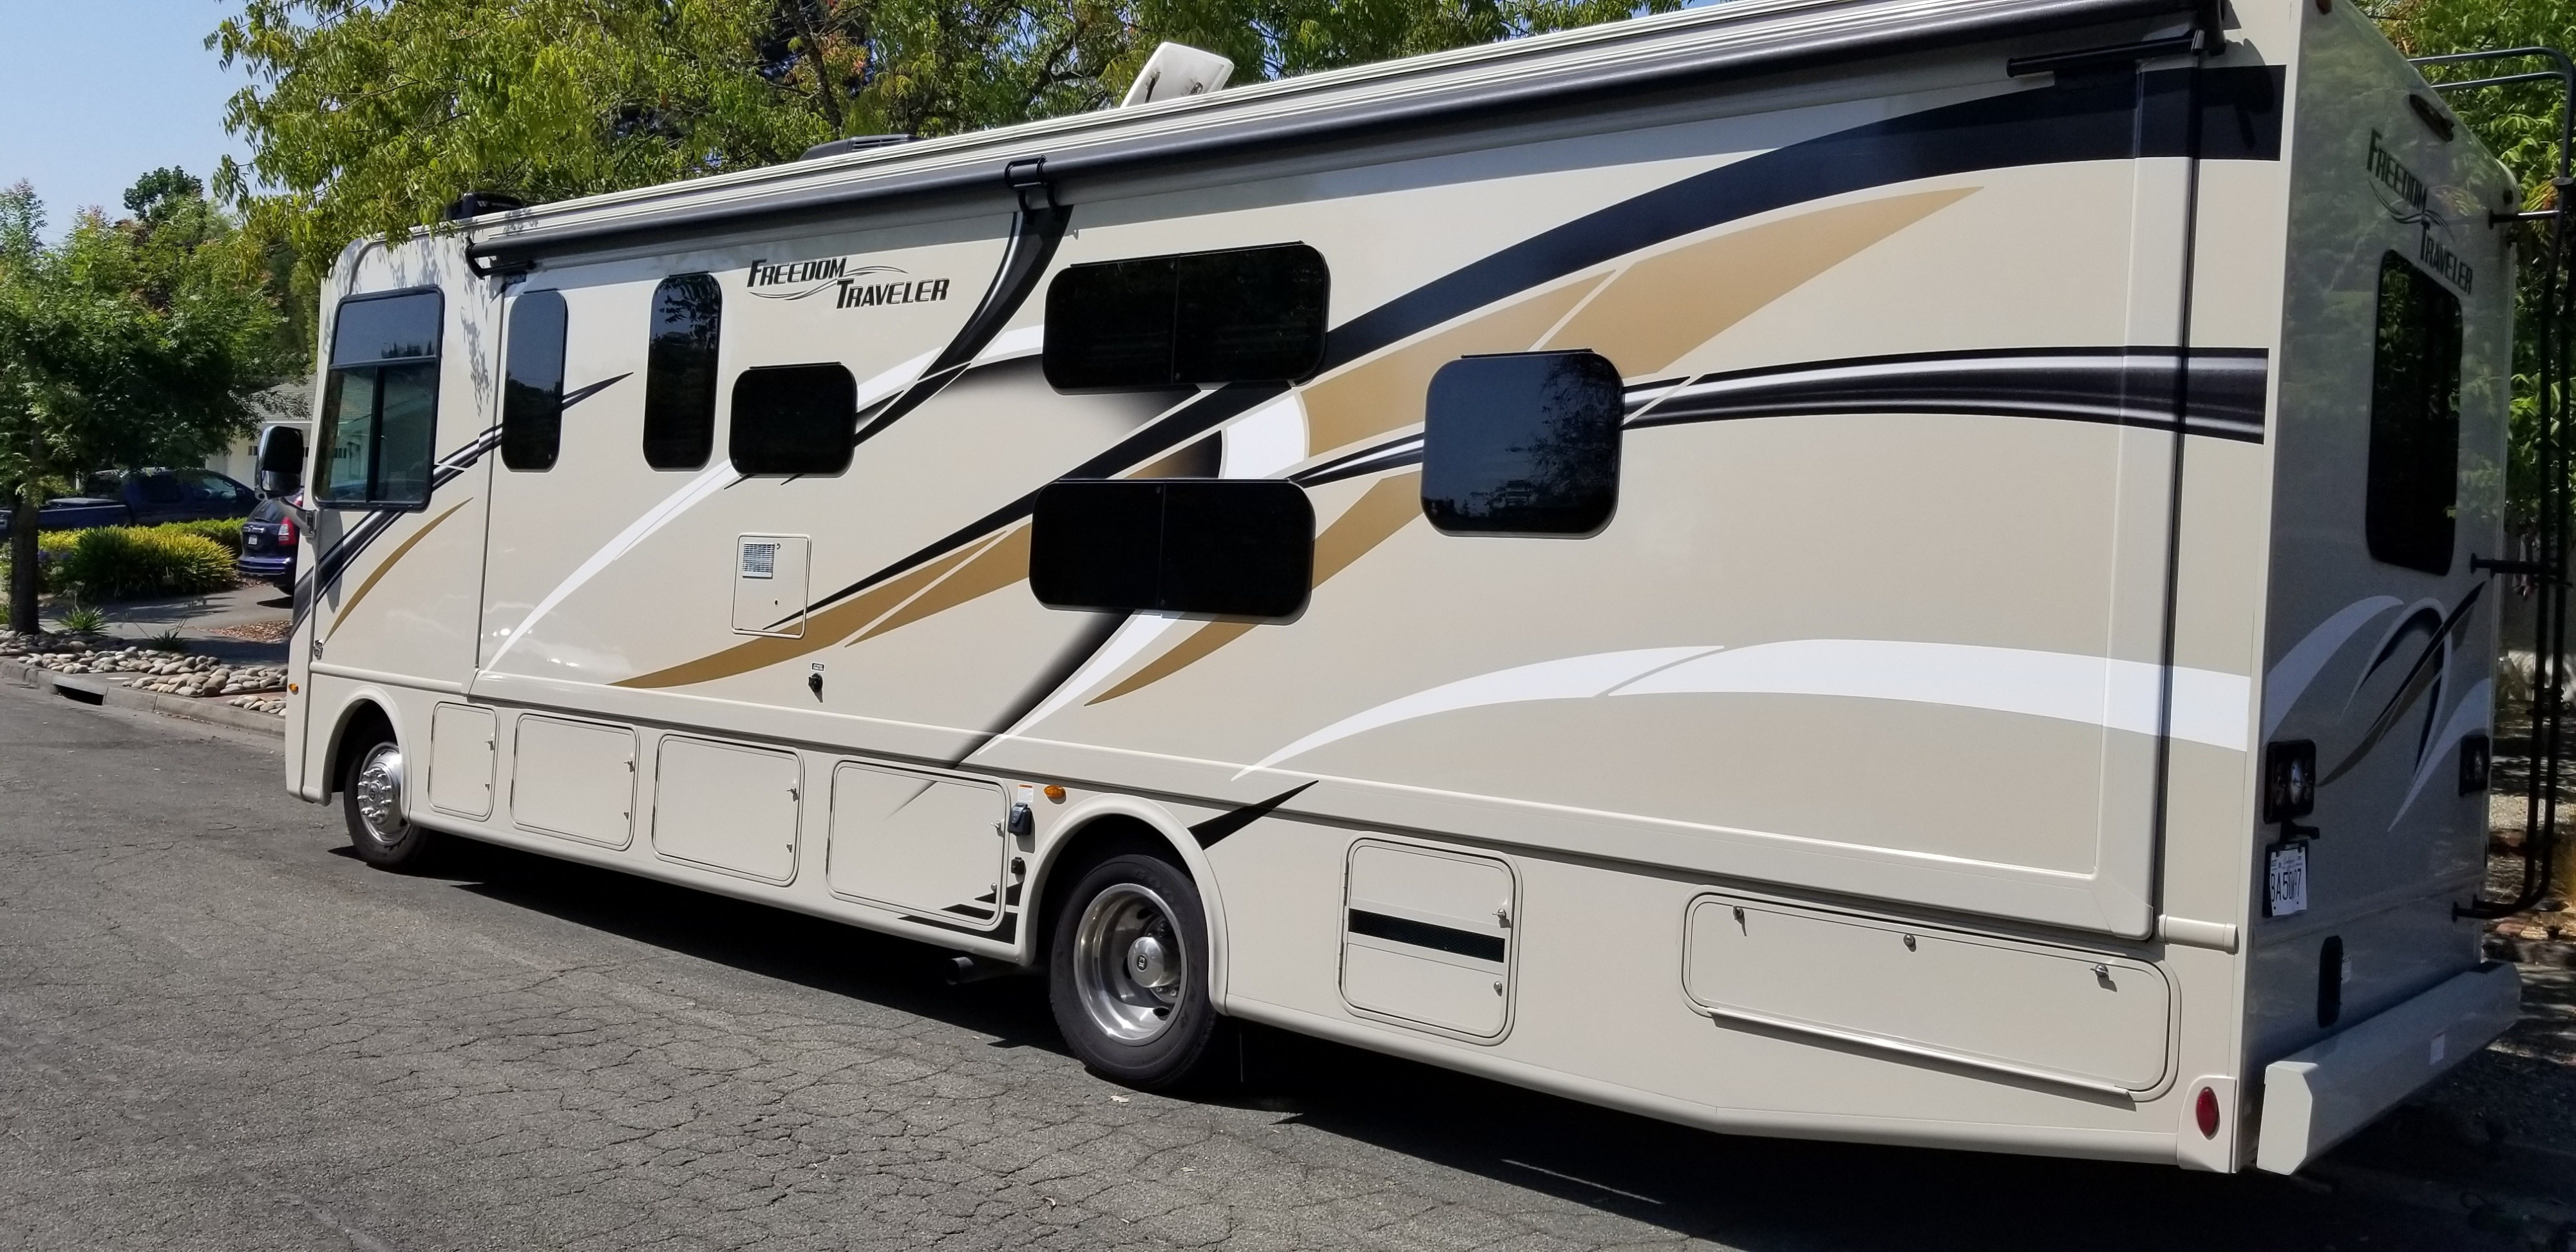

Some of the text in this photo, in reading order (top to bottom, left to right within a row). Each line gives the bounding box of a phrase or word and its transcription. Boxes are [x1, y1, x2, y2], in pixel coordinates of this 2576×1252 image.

[2367, 128, 2427, 213] FREEDOM
[746, 257, 848, 288] FREEDOM
[2420, 218, 2473, 295] TRAVELER
[836, 278, 950, 309] TRAVELER
